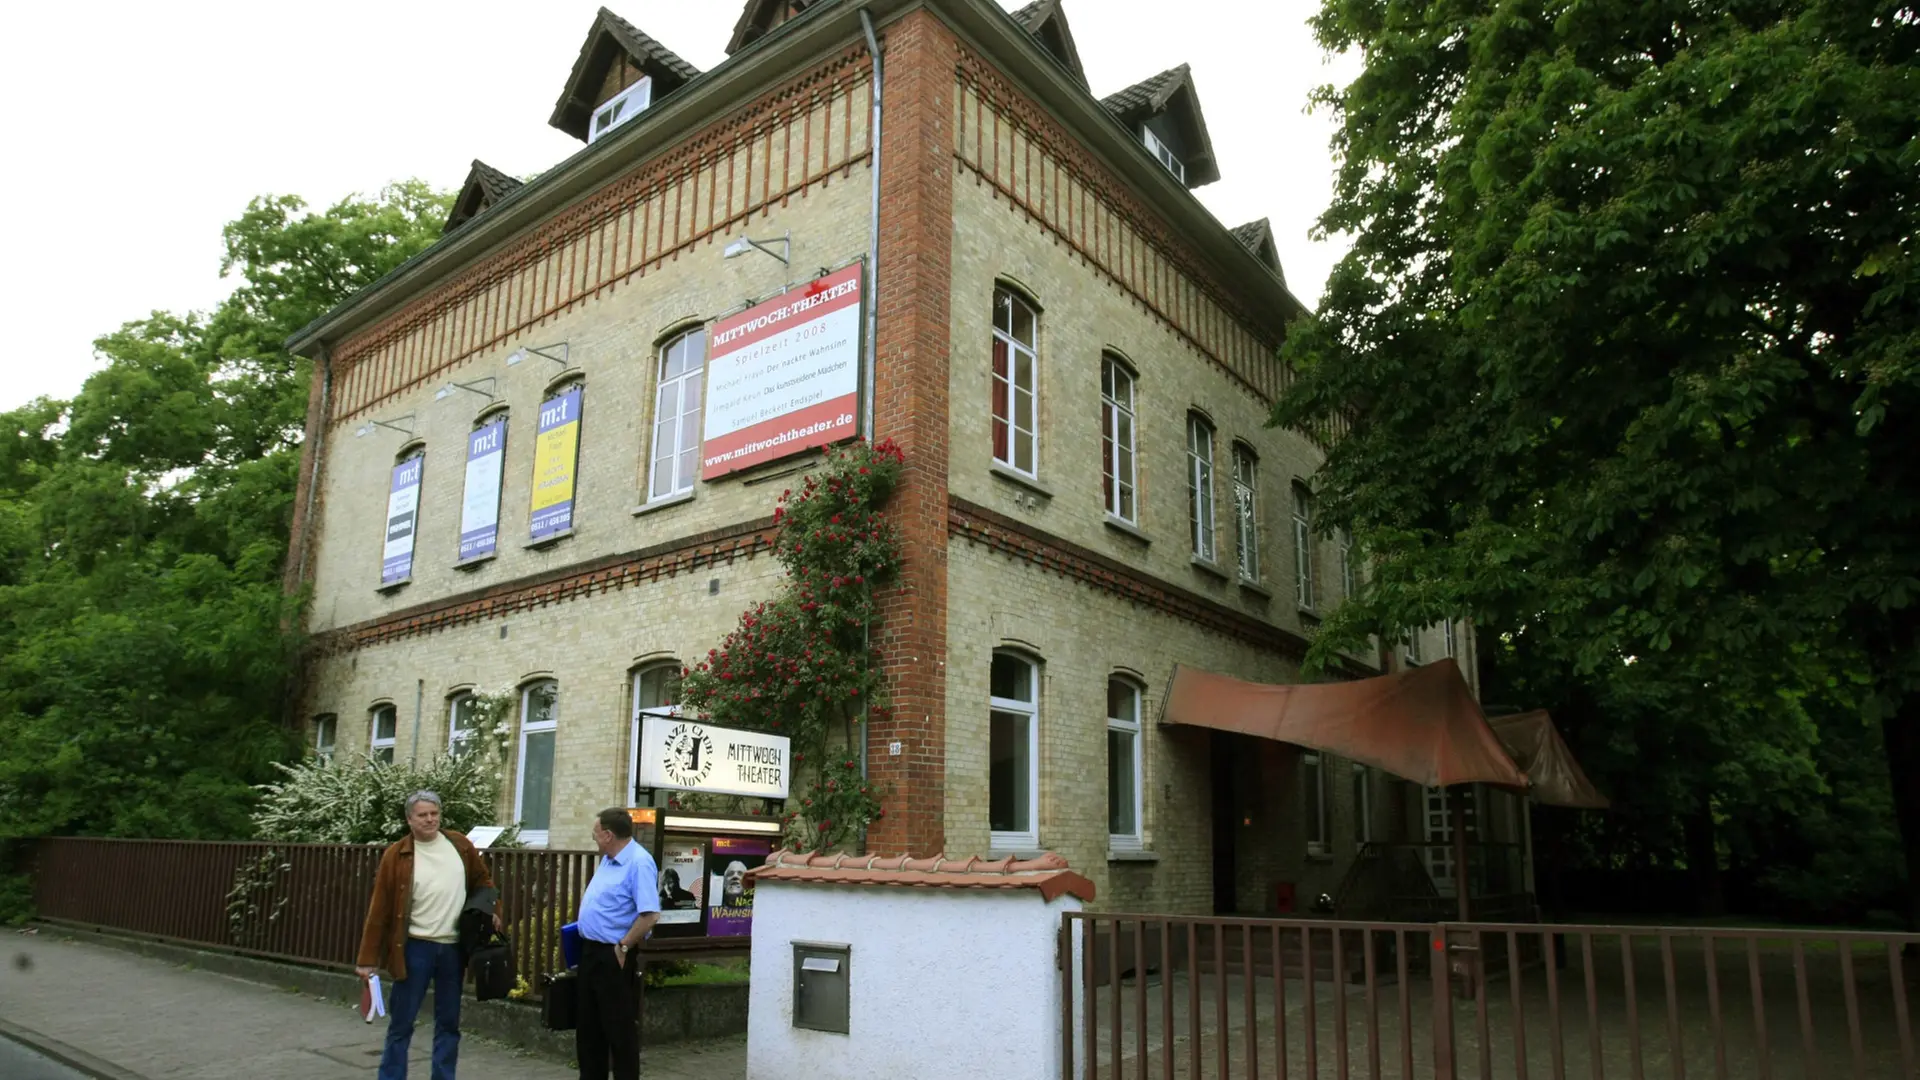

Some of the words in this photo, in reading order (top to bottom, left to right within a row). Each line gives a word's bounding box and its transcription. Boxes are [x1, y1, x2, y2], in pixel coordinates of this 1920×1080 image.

[735, 338, 788, 366] Spielzeit
[795, 322, 827, 343] 2008
[766, 362, 780, 374] Der
[781, 352, 807, 368] nackte
[809, 338, 847, 358] Wahnsinn
[763, 384, 775, 396] Das
[540, 398, 568, 428] m:t
[731, 411, 758, 428] Samuel
[760, 401, 788, 418] Beckett
[790, 389, 823, 408] Endspiel
[473, 427, 498, 455] m:t
[704, 413, 854, 468] www.mittwochtheater.de
[399, 460, 420, 486] m:t
[664, 723, 688, 751] JAZZ
[691, 725, 713, 755] CLUB
[727, 743, 782, 766] MITTWOCH
[663, 758, 713, 787] HANNOVER
[737, 764, 782, 788] THEATER
[735, 896, 753, 907] NAC
